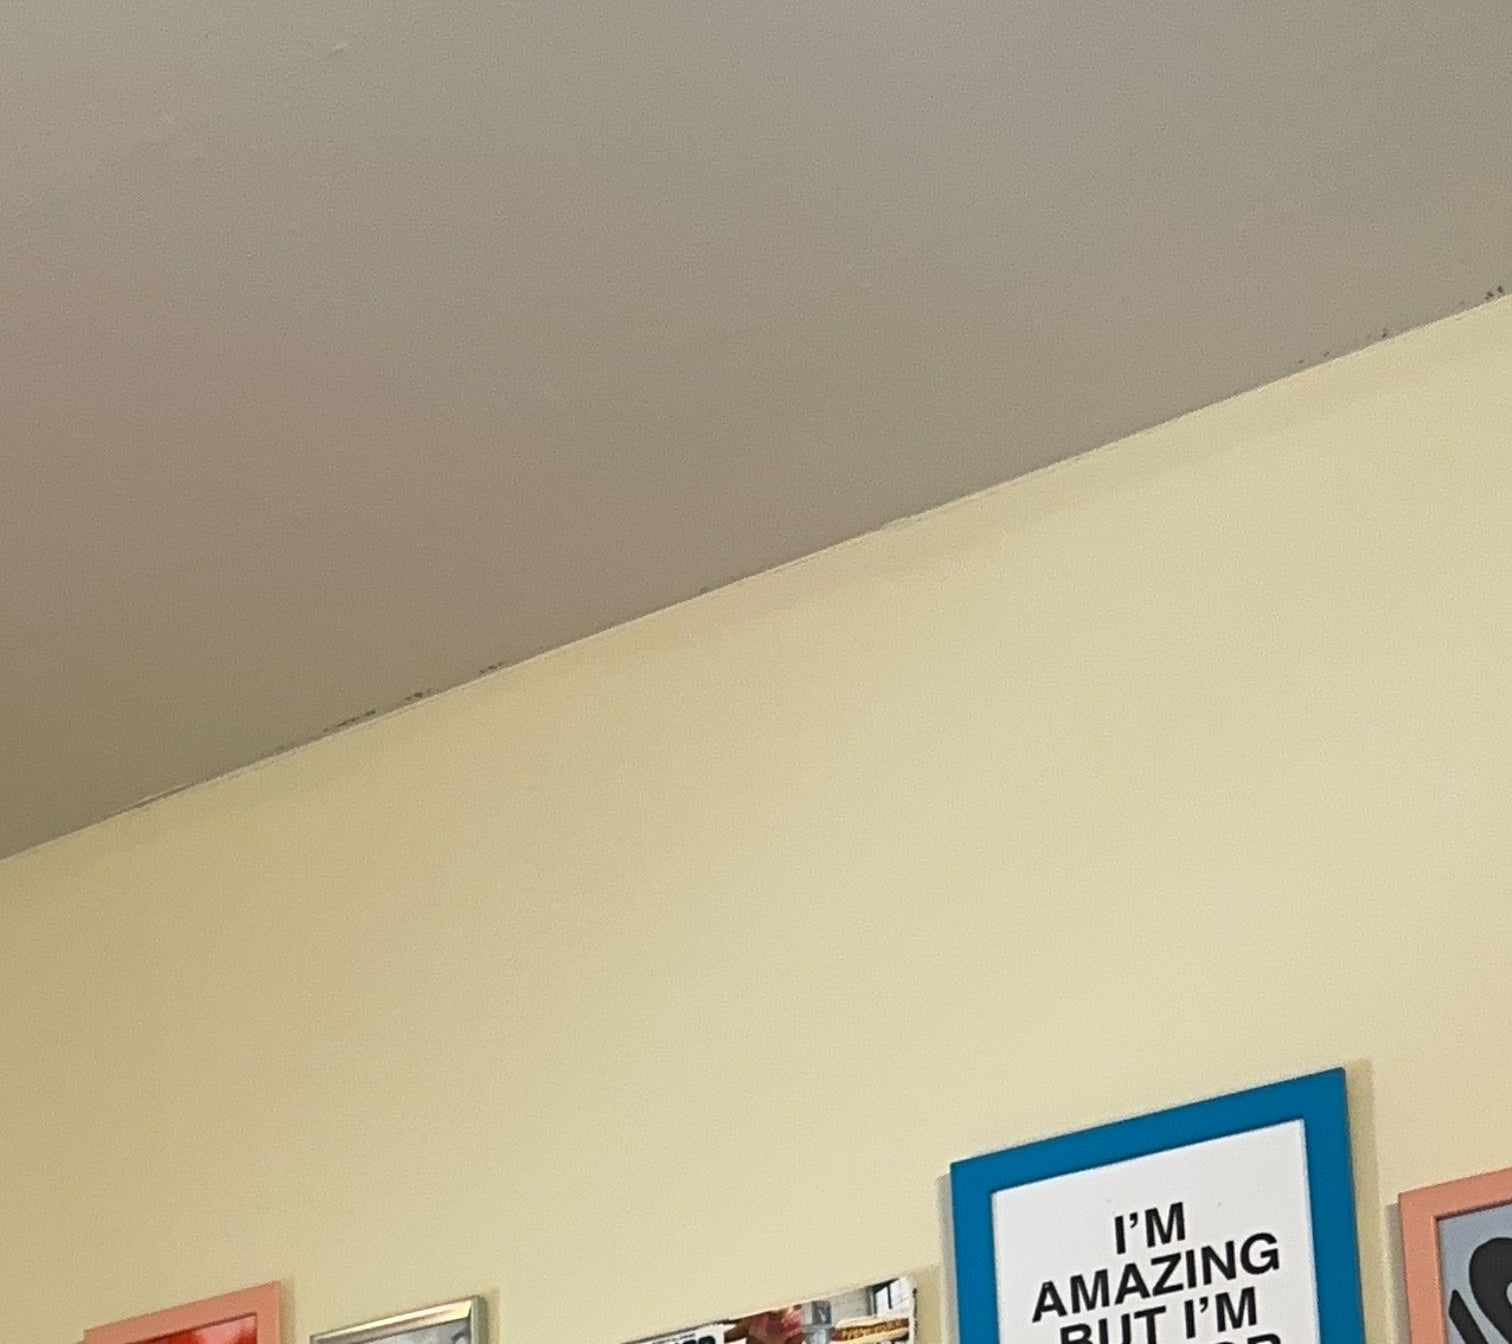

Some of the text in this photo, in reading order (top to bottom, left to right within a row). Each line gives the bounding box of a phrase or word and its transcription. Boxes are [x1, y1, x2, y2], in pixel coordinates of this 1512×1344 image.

[1112, 1201, 1186, 1256] I'M
[1030, 1231, 1282, 1323] AMAZING
[1184, 1286, 1259, 1340] I'M
